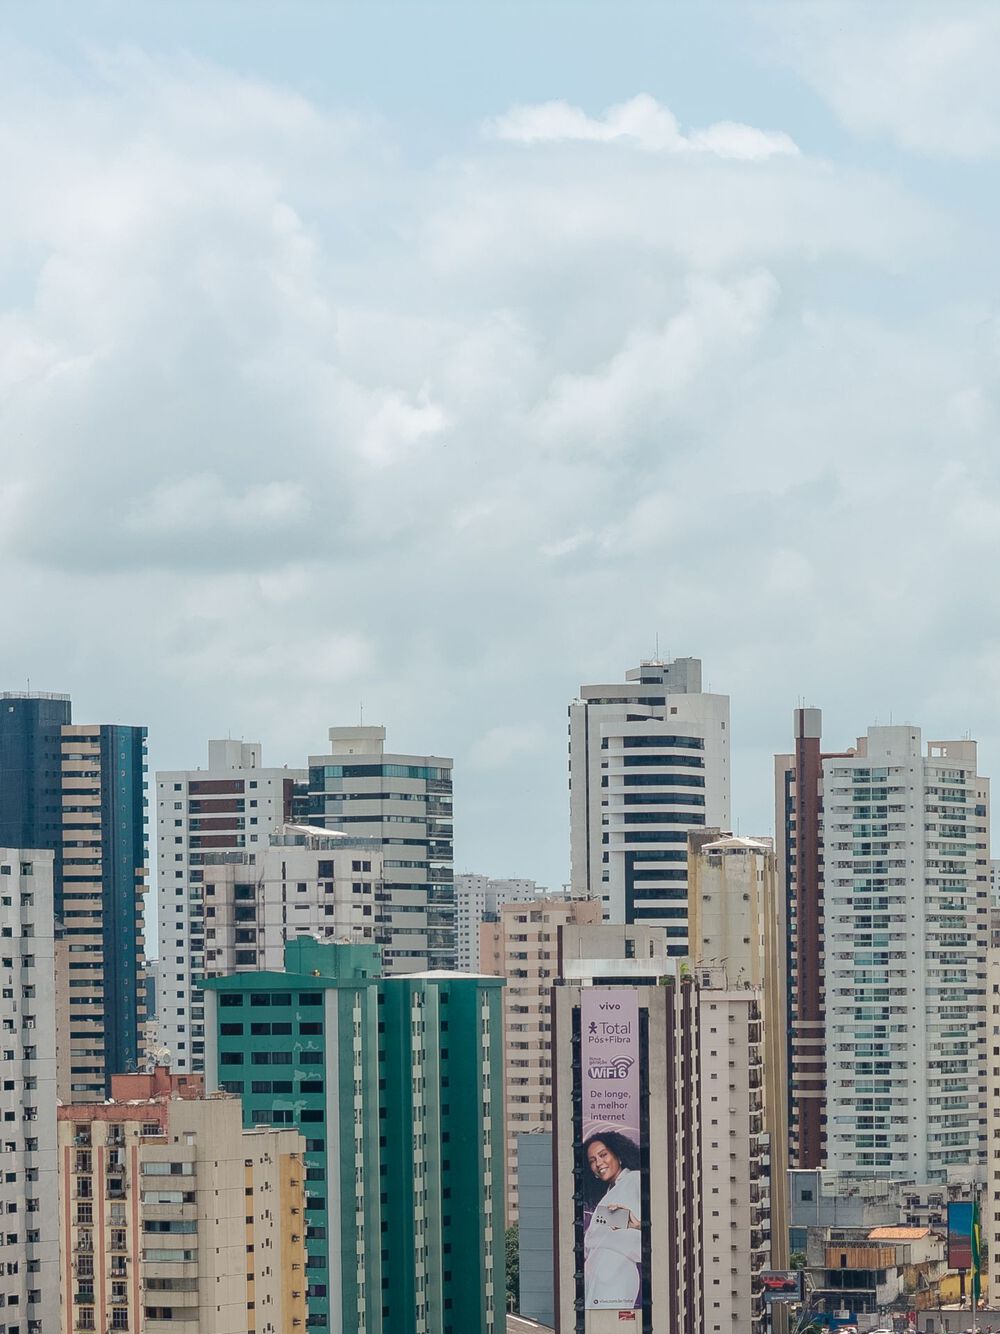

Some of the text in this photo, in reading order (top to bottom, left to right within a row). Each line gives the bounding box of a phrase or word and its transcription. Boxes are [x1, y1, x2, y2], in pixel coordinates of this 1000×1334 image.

[599, 1002, 621, 1010] vivo
[599, 1021, 631, 1035] Total
[588, 1036, 631, 1044] Pós+Fibra
[591, 1065, 627, 1078] WiFi 6
[590, 1090, 631, 1100] De longe,
[598, 1101, 628, 1109] melhor
[590, 1112, 626, 1121] internet
